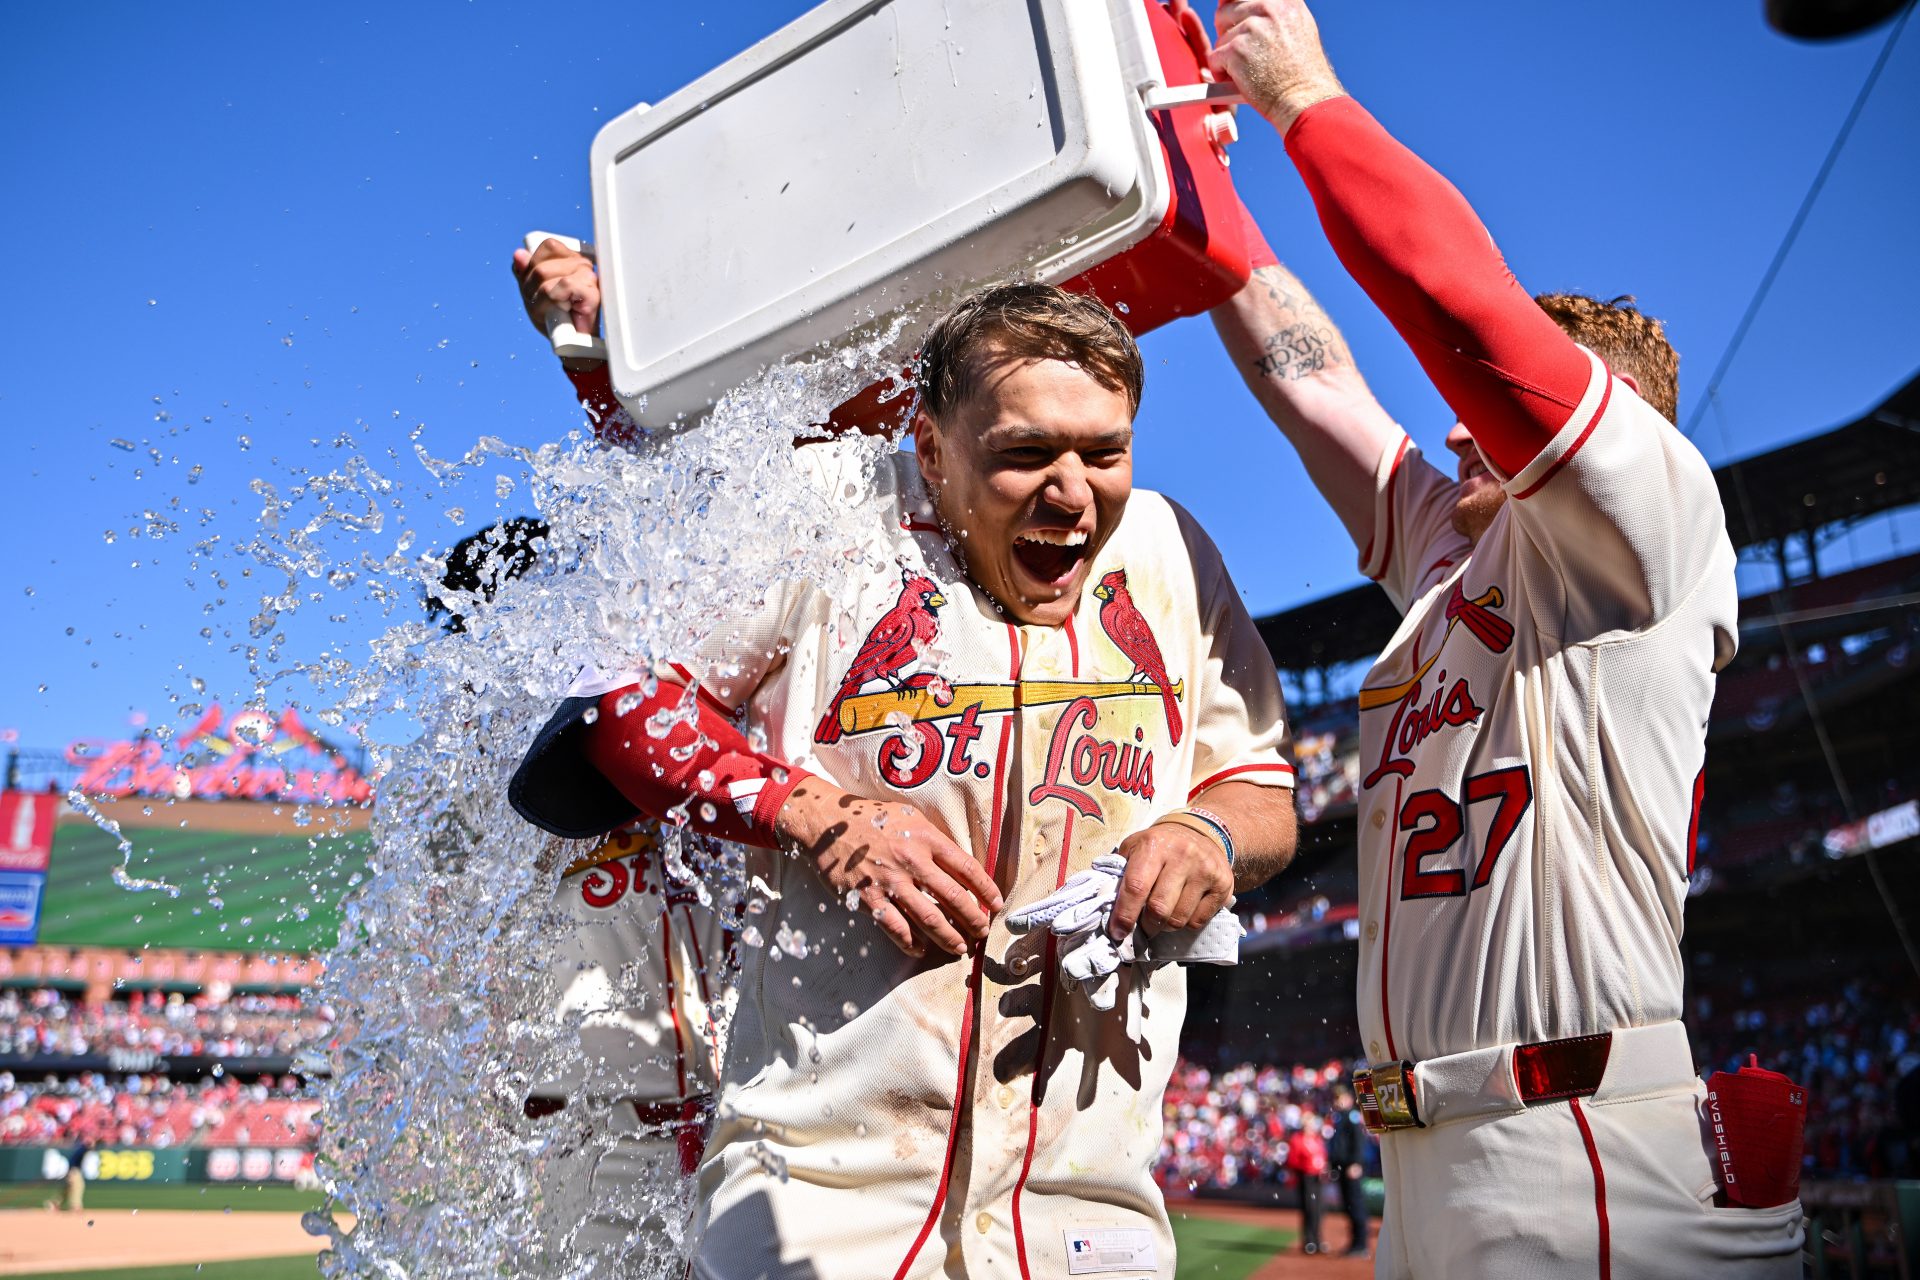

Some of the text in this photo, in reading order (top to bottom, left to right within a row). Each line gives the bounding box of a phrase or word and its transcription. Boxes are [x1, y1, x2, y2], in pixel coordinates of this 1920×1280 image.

[878, 672, 1154, 825] St. Louis
[582, 831, 658, 908] St.
[1400, 764, 1533, 901] 27
[1378, 1084, 1399, 1113] 27
[1709, 1091, 1735, 1184] EVOSHIELD
